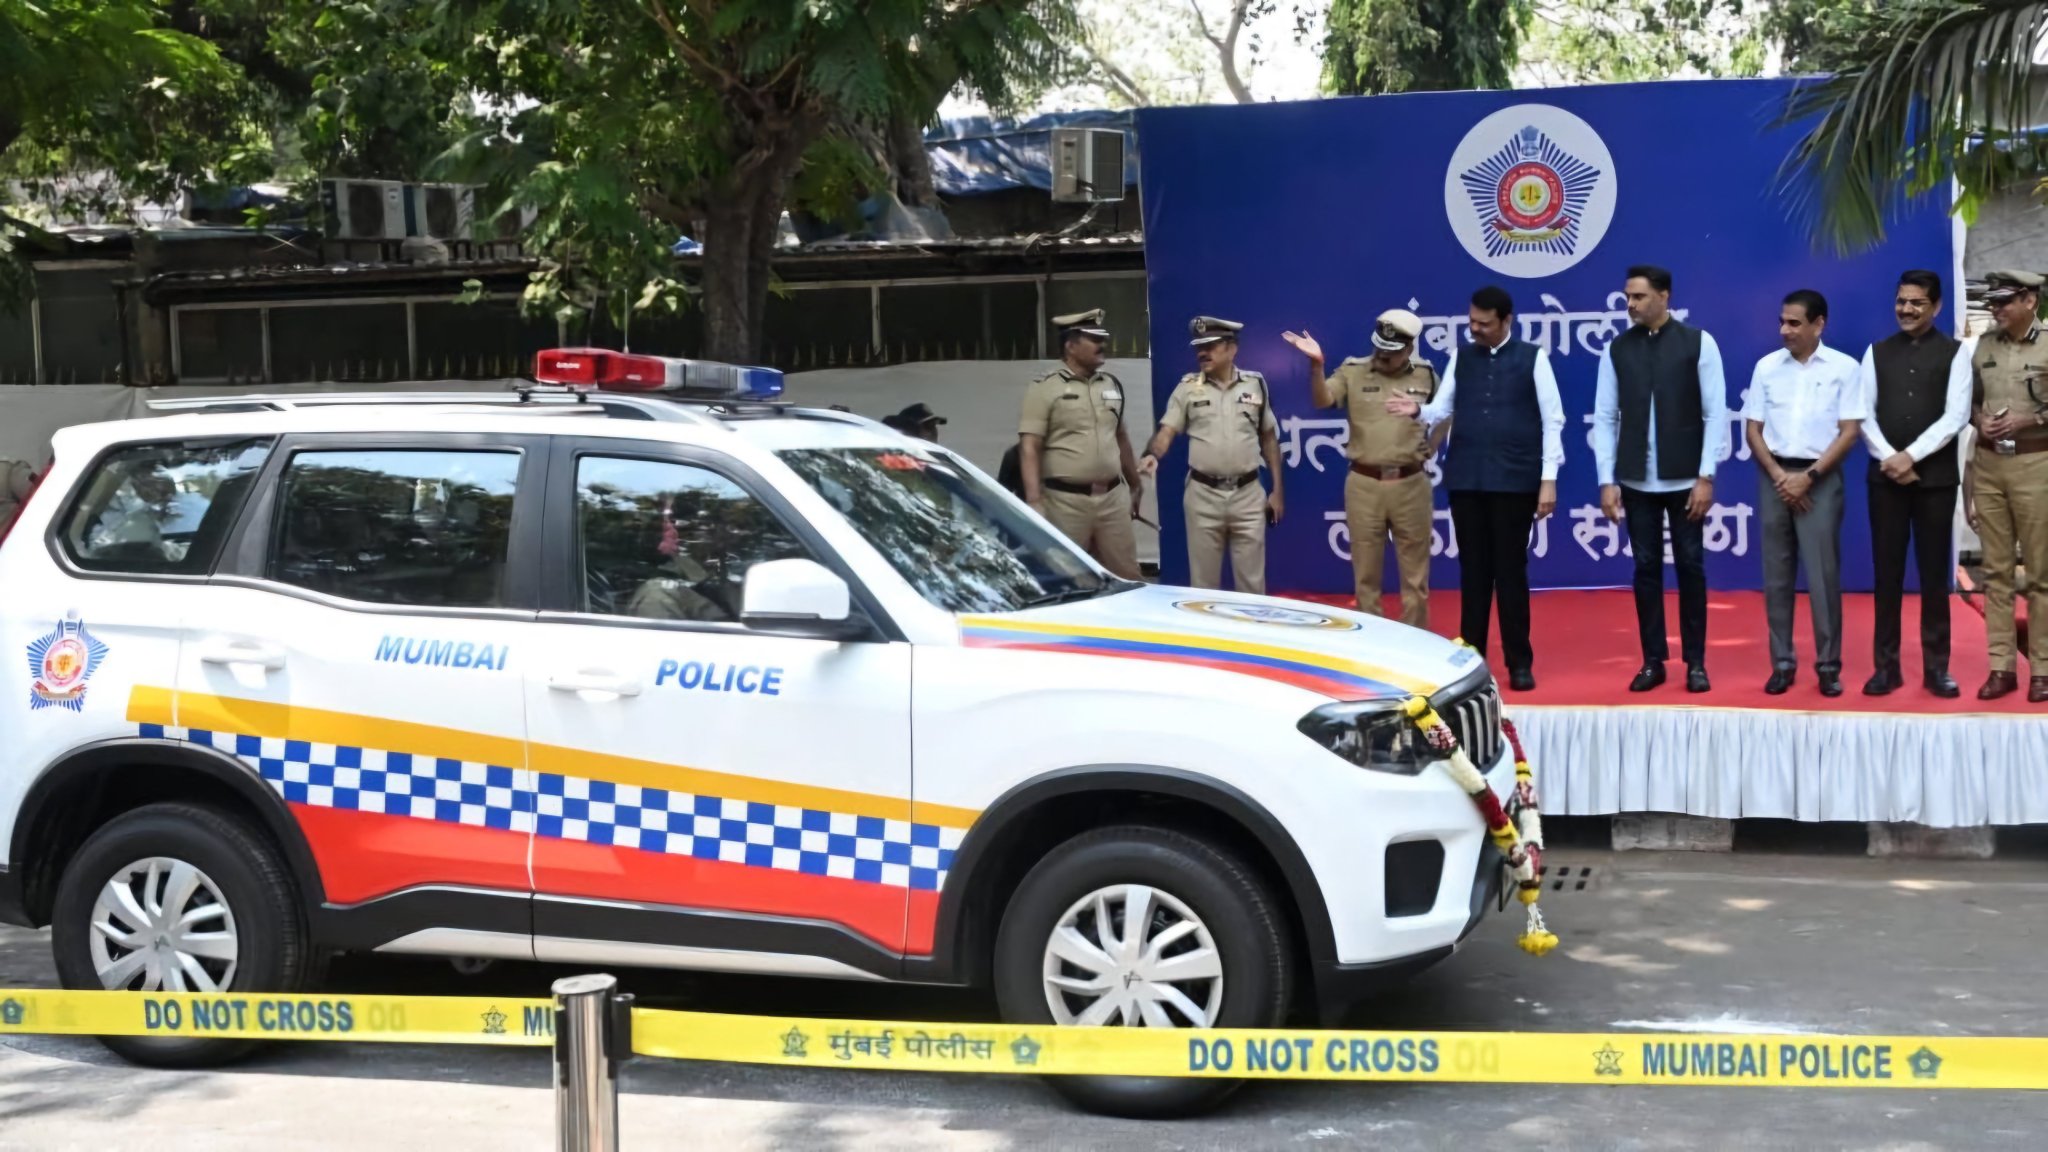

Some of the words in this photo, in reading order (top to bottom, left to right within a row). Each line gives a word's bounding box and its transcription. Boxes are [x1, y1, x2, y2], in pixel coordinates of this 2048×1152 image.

[374, 634, 510, 672] MUMBAI
[654, 658, 785, 696] POLICE
[144, 999, 183, 1030] DO
[191, 999, 249, 1031] NOT
[257, 1000, 354, 1033] CROSS
[828, 1029, 895, 1061] मुंबई
[903, 1030, 995, 1061] पोलीस
[1188, 1038, 1233, 1071] DO
[1246, 1038, 1313, 1072] NOT
[1325, 1038, 1440, 1073] CROSS
[1642, 1042, 1768, 1077] MUMBAI
[1779, 1044, 1892, 1080] POLICE
